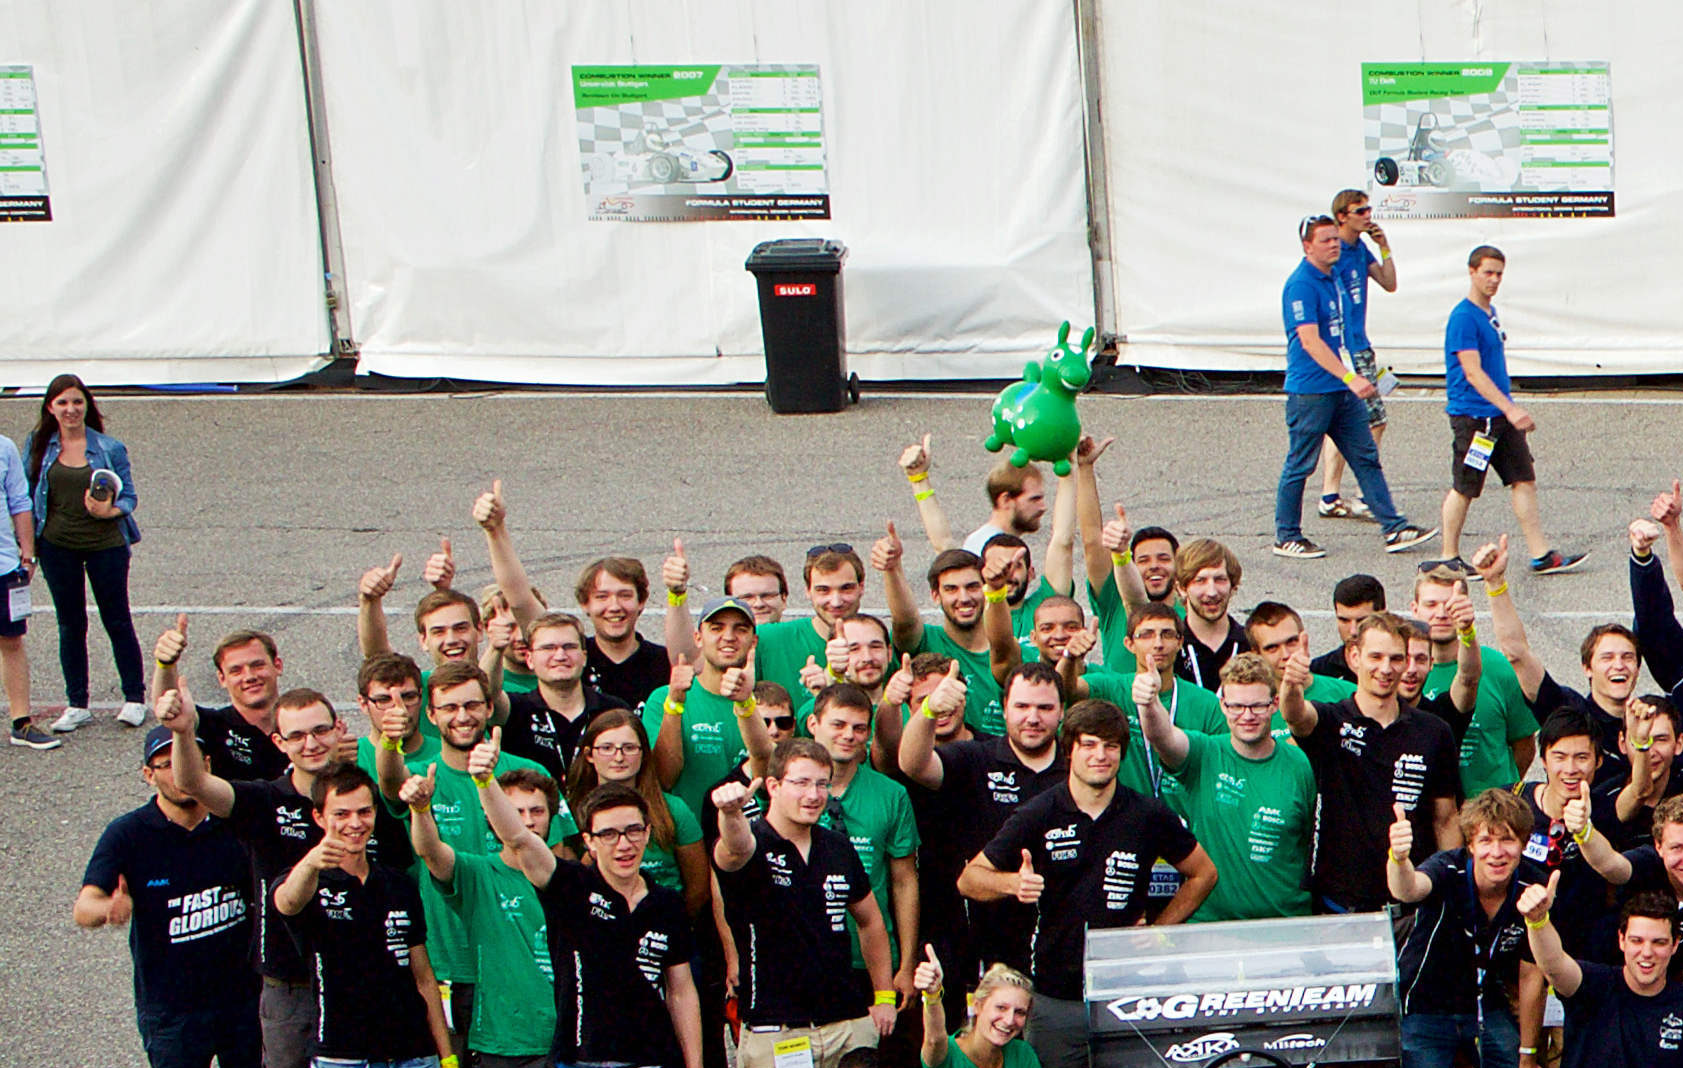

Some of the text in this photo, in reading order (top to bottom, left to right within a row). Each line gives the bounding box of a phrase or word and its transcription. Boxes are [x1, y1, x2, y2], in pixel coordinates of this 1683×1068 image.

[673, 71, 704, 80] 2007
[1468, 196, 1609, 204] FORMULA STUDENT GERMANY
[779, 286, 811, 295] SULO
[1399, 753, 1424, 764] AMK
[1258, 806, 1281, 817] AMK
[1111, 850, 1137, 862] AMK
[1149, 884, 1178, 894] 0382
[183, 886, 222, 914] FAST
[169, 898, 247, 936] GLORIOUS
[645, 931, 668, 943] AMK
